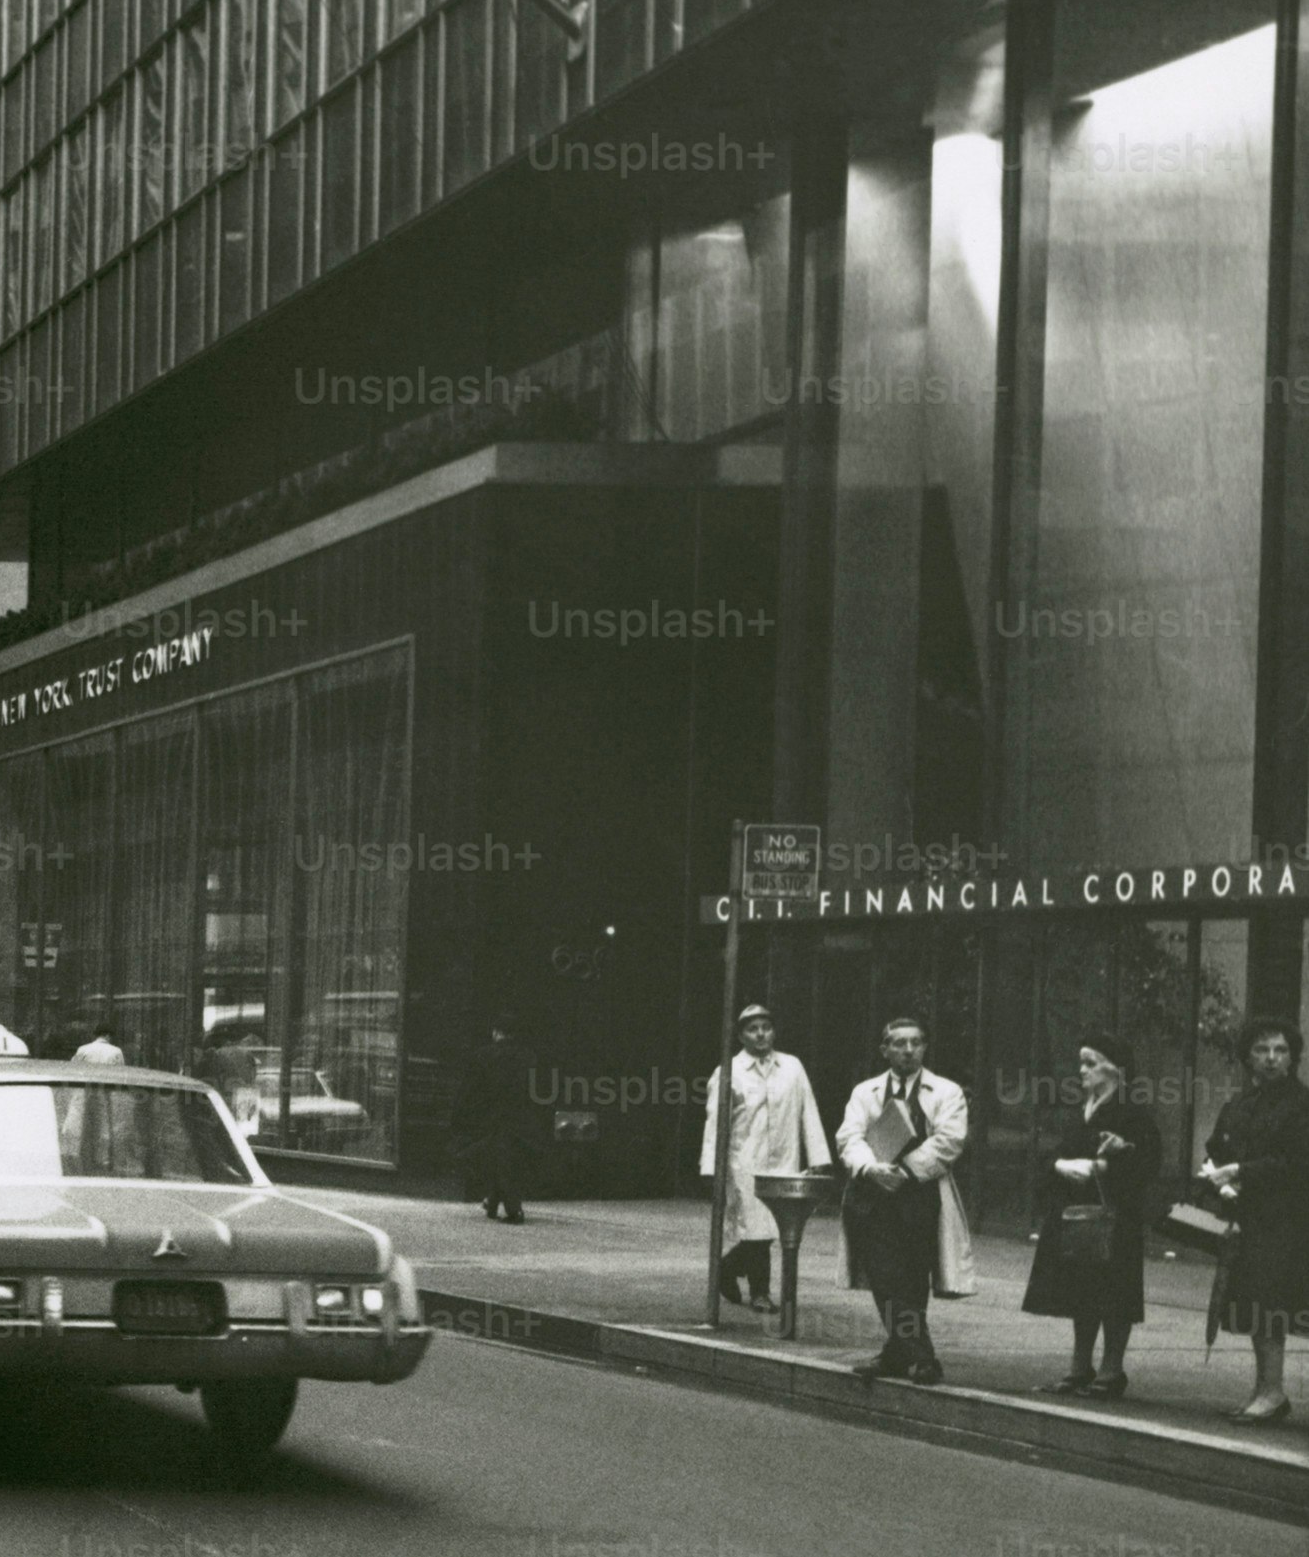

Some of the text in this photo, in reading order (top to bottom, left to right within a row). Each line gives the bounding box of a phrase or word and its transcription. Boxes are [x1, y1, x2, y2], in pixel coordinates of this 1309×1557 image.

[1, 694, 26, 726] NEW
[34, 679, 74, 715] YORK
[79, 657, 124, 700] TRUST
[132, 627, 214, 683] COMPANY
[768, 834, 797, 848] NO
[753, 850, 810, 865] STANDING
[753, 875, 810, 890] BUS STOP
[819, 877, 1054, 917] FINANCIAL
[1084, 863, 1295, 904] CORPORA
